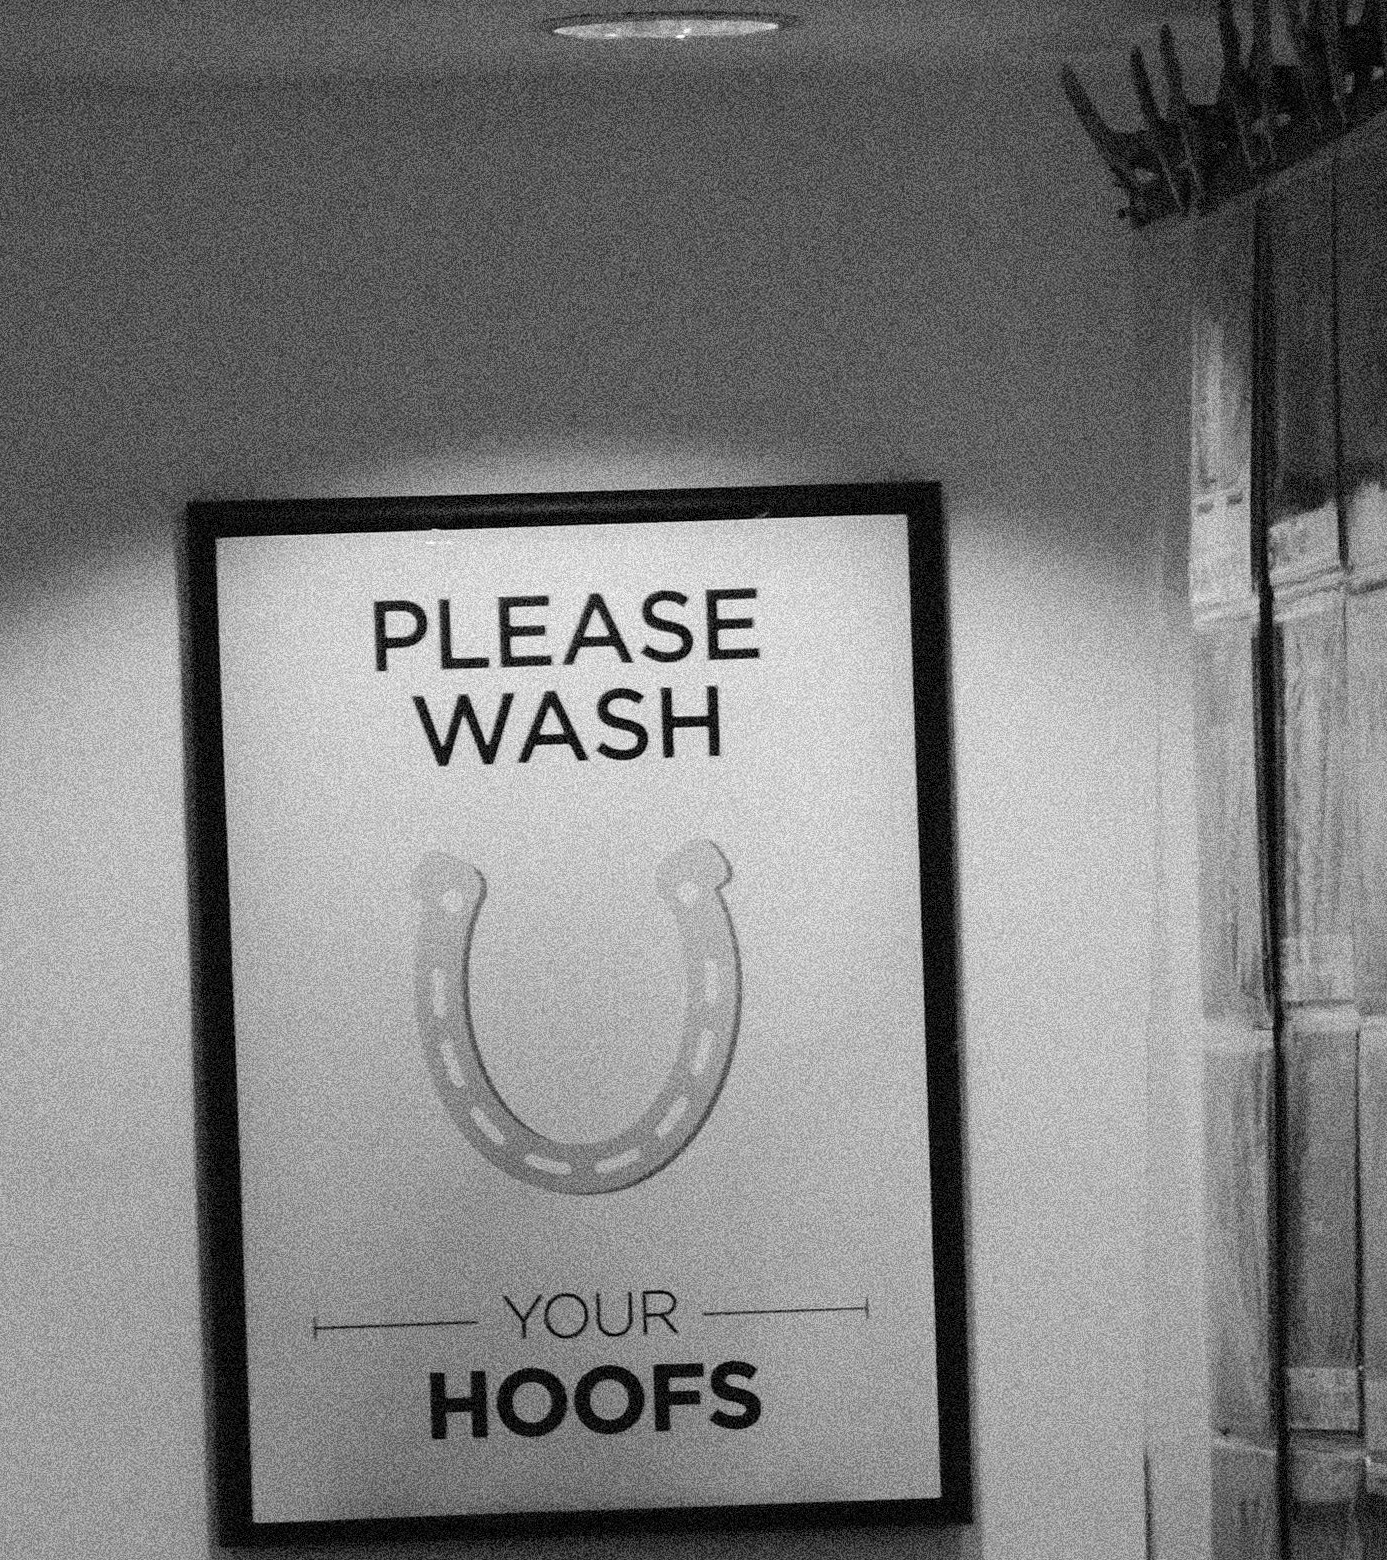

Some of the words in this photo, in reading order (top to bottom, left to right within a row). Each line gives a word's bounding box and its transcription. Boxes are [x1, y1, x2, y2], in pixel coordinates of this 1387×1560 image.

[373, 588, 761, 672] PLEASE
[413, 685, 722, 767] WASH
[502, 1289, 679, 1341] YOUR
[429, 1360, 762, 1440] HOOFS
